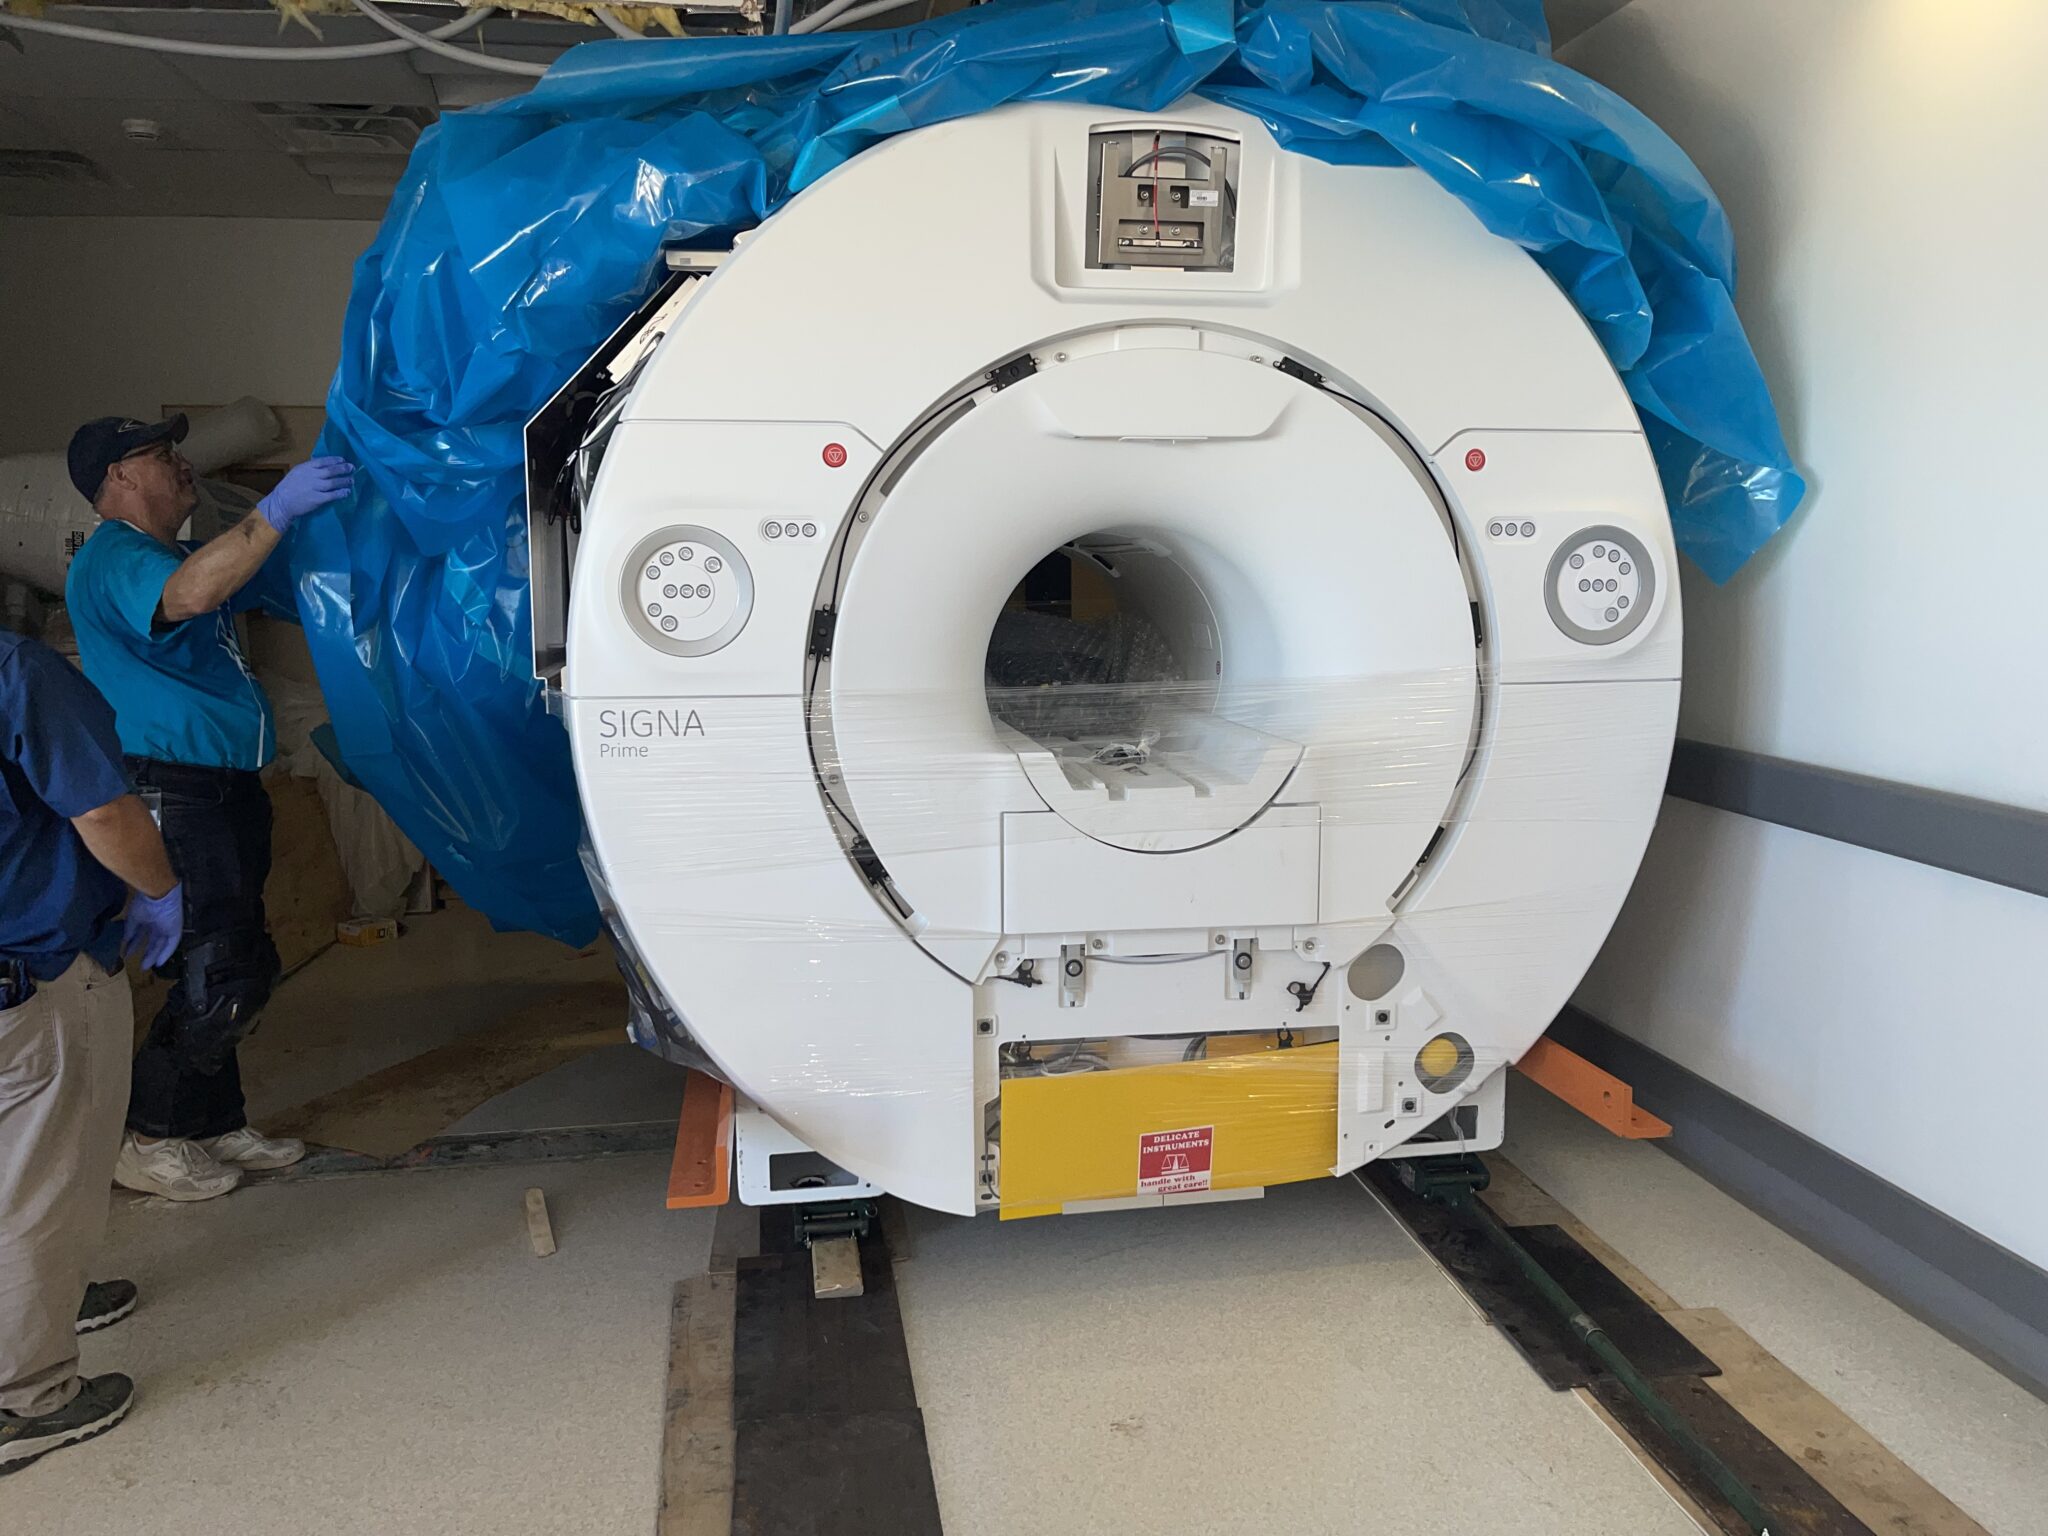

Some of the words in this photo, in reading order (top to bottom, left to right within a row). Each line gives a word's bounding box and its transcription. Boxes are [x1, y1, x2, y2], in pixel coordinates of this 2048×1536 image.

[600, 709, 705, 738] SIGNA
[600, 742, 648, 758] Prime
[1154, 1131, 1200, 1143] DELICATE
[1143, 1139, 1209, 1154] INSTRUMENTS
[1141, 1178, 1171, 1187] handle
[1174, 1175, 1195, 1183] with
[1158, 1183, 1182, 1193] great
[1184, 1179, 1208, 1188] care!!
